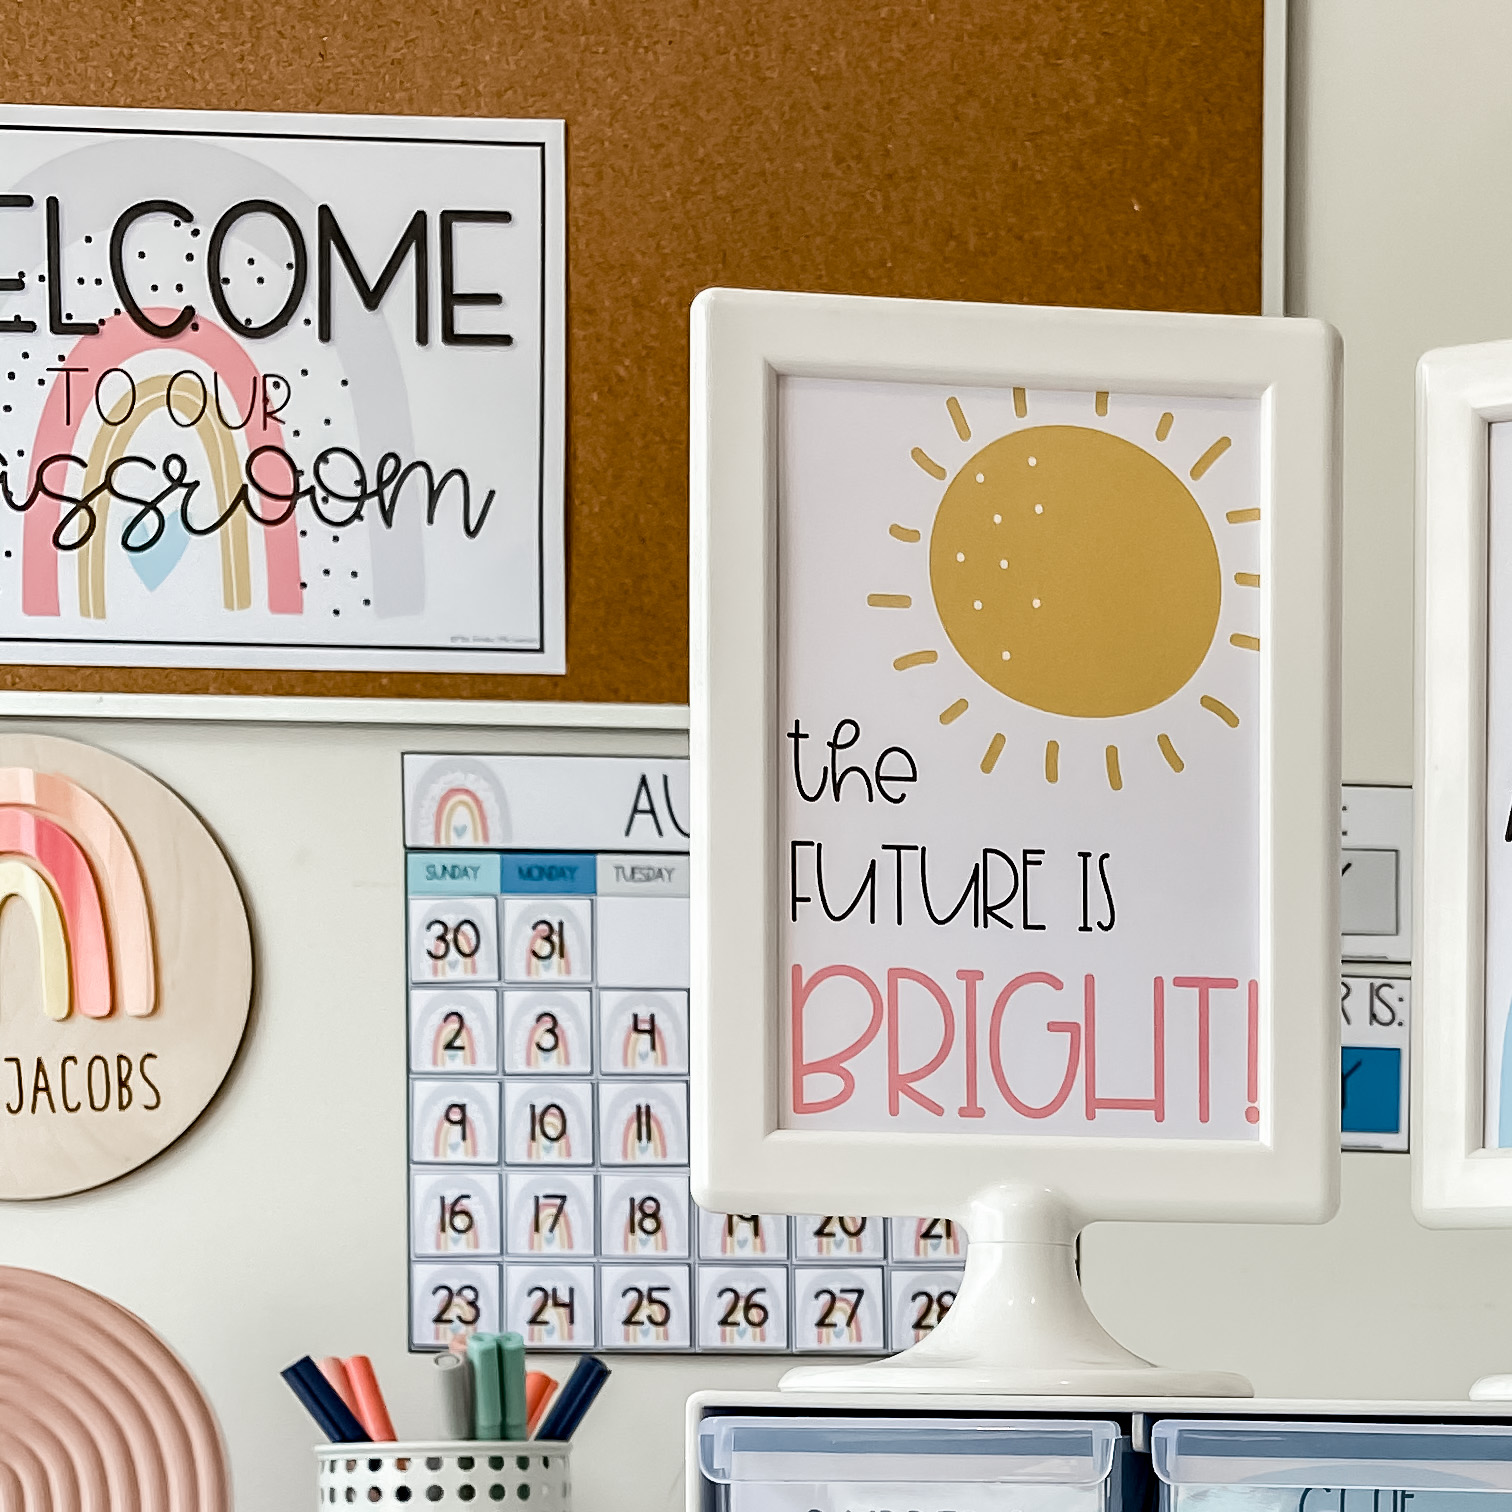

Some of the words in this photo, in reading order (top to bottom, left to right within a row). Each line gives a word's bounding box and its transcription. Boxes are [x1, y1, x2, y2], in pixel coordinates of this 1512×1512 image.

[46, 366, 137, 426] TO
[165, 369, 291, 431] OUR
[786, 719, 919, 804] the
[425, 864, 480, 882] SUNDAY
[517, 865, 580, 882] MONDAY
[613, 865, 675, 883] TUESDAY
[790, 841, 1046, 932] FUTURE
[1076, 852, 1116, 932] IS
[425, 918, 481, 961] 30
[531, 918, 566, 961] 31
[442, 1010, 467, 1053] 2
[534, 1010, 560, 1053] 3
[631, 1010, 657, 1053] 4
[791, 963, 1260, 1124] BRIGHT!
[3, 1052, 163, 1115] JACOBS
[445, 1102, 469, 1142] 9
[529, 1102, 567, 1143] 10
[634, 1102, 653, 1144] 11
[438, 1193, 475, 1236] 16
[532, 1193, 568, 1236] 17
[627, 1194, 662, 1236] 18
[431, 1283, 480, 1325] 23
[526, 1285, 575, 1325] 24
[621, 1285, 671, 1326] 25
[717, 1287, 769, 1328] 26
[814, 1288, 865, 1329] 27
